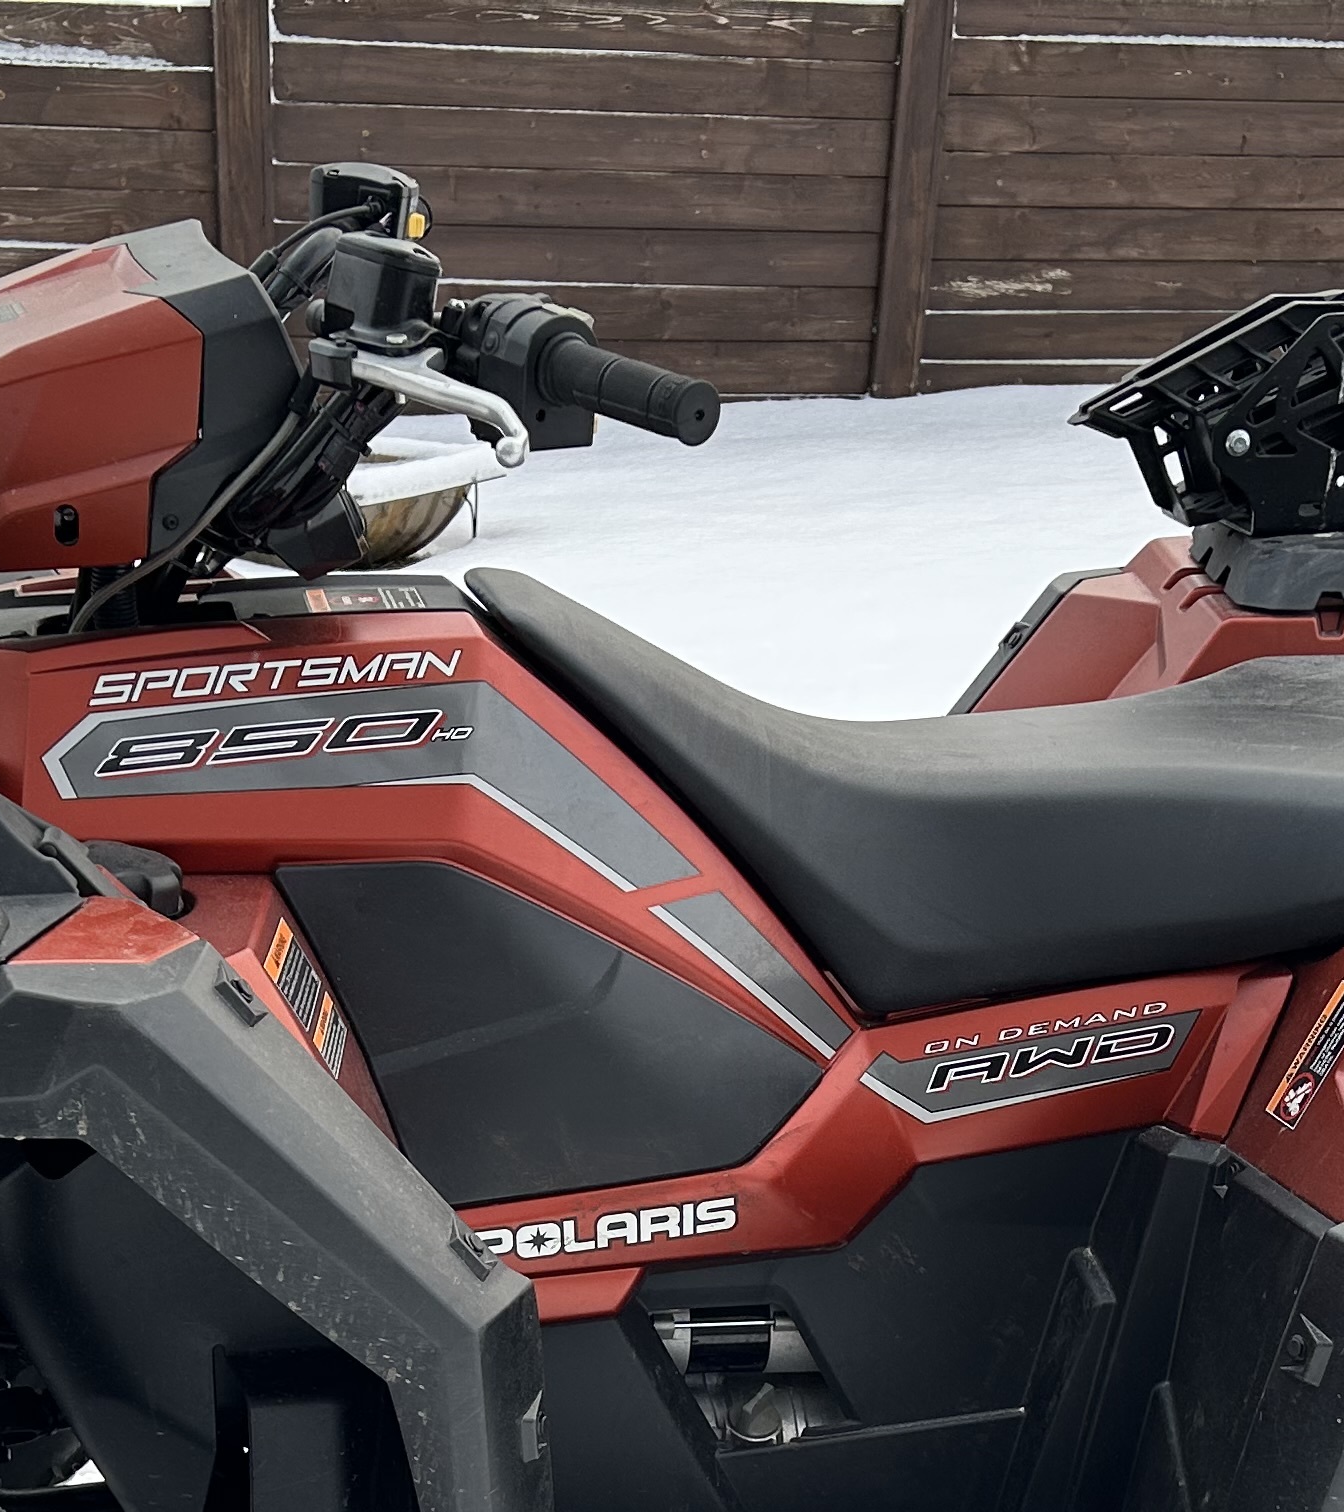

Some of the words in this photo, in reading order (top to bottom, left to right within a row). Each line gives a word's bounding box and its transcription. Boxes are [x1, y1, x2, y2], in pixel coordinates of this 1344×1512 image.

[89, 649, 462, 707] SPORTSMAN
[94, 708, 446, 779] 850
[924, 1034, 980, 1054] ON
[998, 1001, 1168, 1042] DEMAND
[1292, 1014, 1328, 1070] WARNING
[925, 1023, 1175, 1094] AWD
[475, 1197, 737, 1259] POLARIS
